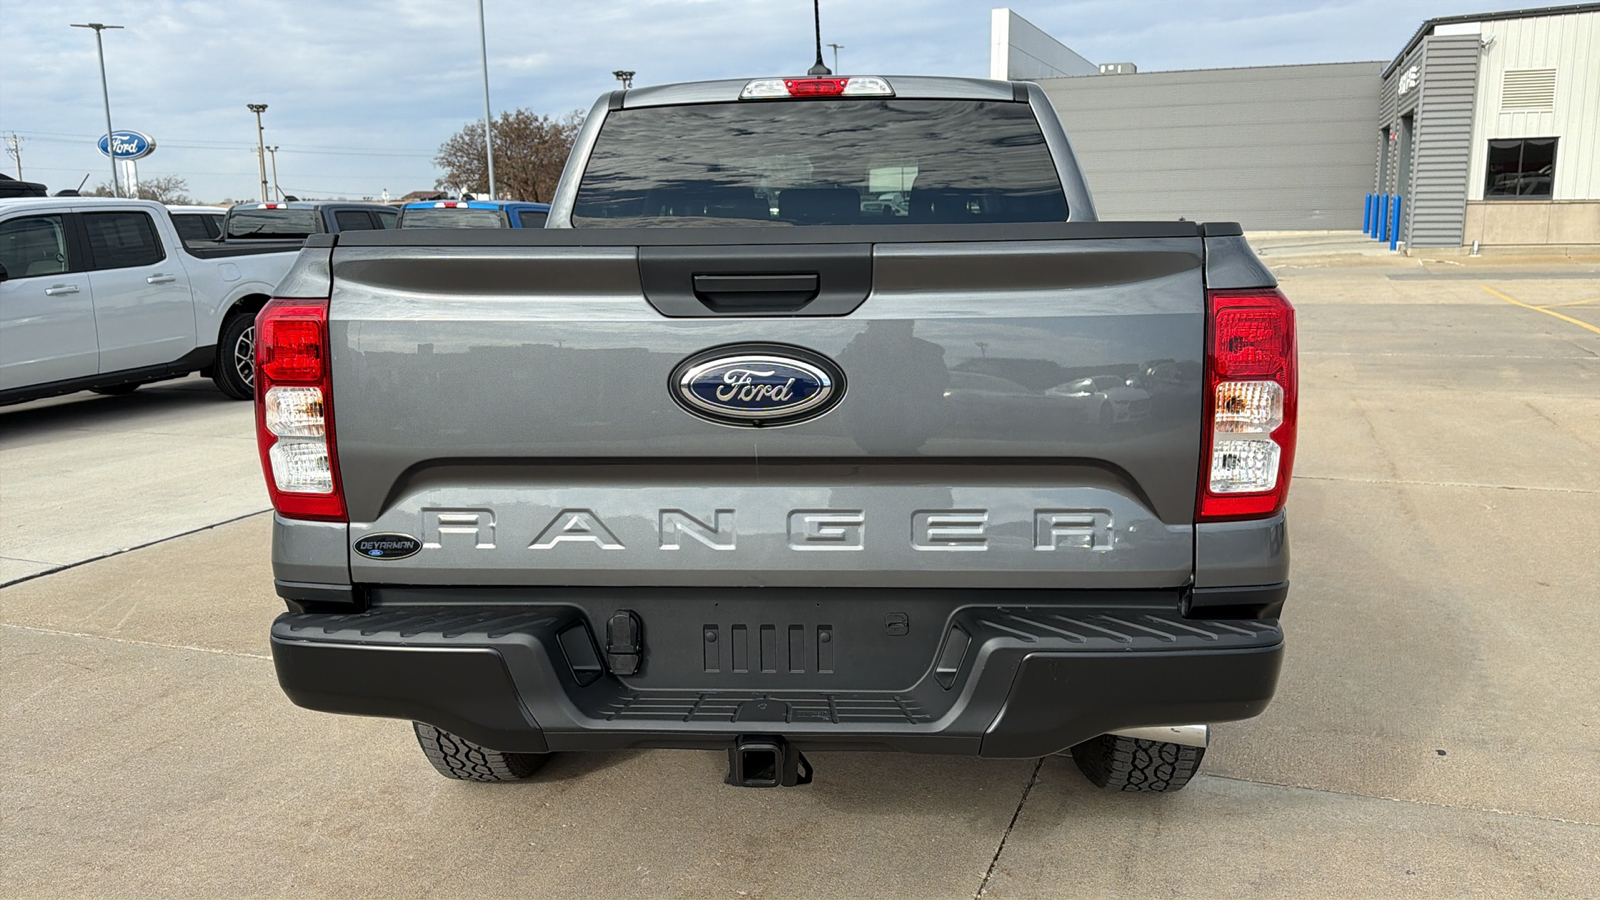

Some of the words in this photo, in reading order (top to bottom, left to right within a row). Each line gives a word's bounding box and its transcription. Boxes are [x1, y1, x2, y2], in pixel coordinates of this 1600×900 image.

[108, 135, 139, 153] Ford
[716, 368, 796, 402] Ford
[420, 507, 1115, 551] RANGER
[360, 541, 415, 550] DEYARMAN
